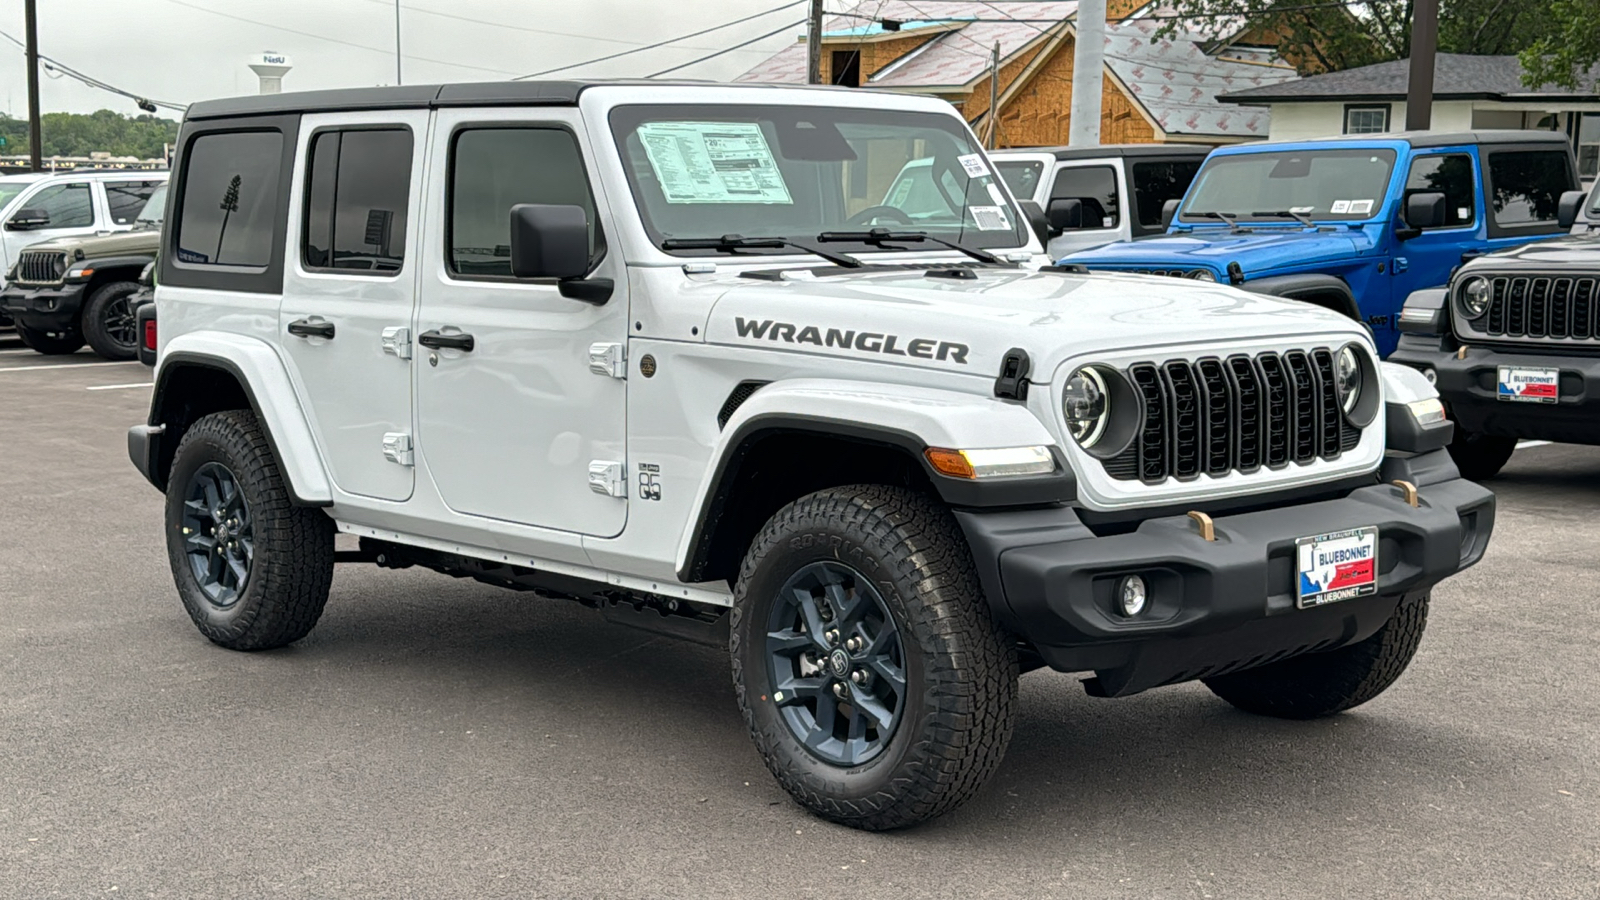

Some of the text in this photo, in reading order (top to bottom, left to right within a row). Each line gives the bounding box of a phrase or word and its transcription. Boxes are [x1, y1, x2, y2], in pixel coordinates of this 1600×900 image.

[734, 316, 970, 365] WRANGLER
[1513, 375, 1554, 384] BLUEBONNET
[1319, 545, 1371, 566] BLUEBONNET
[1316, 587, 1360, 604] BLUEBONNET
